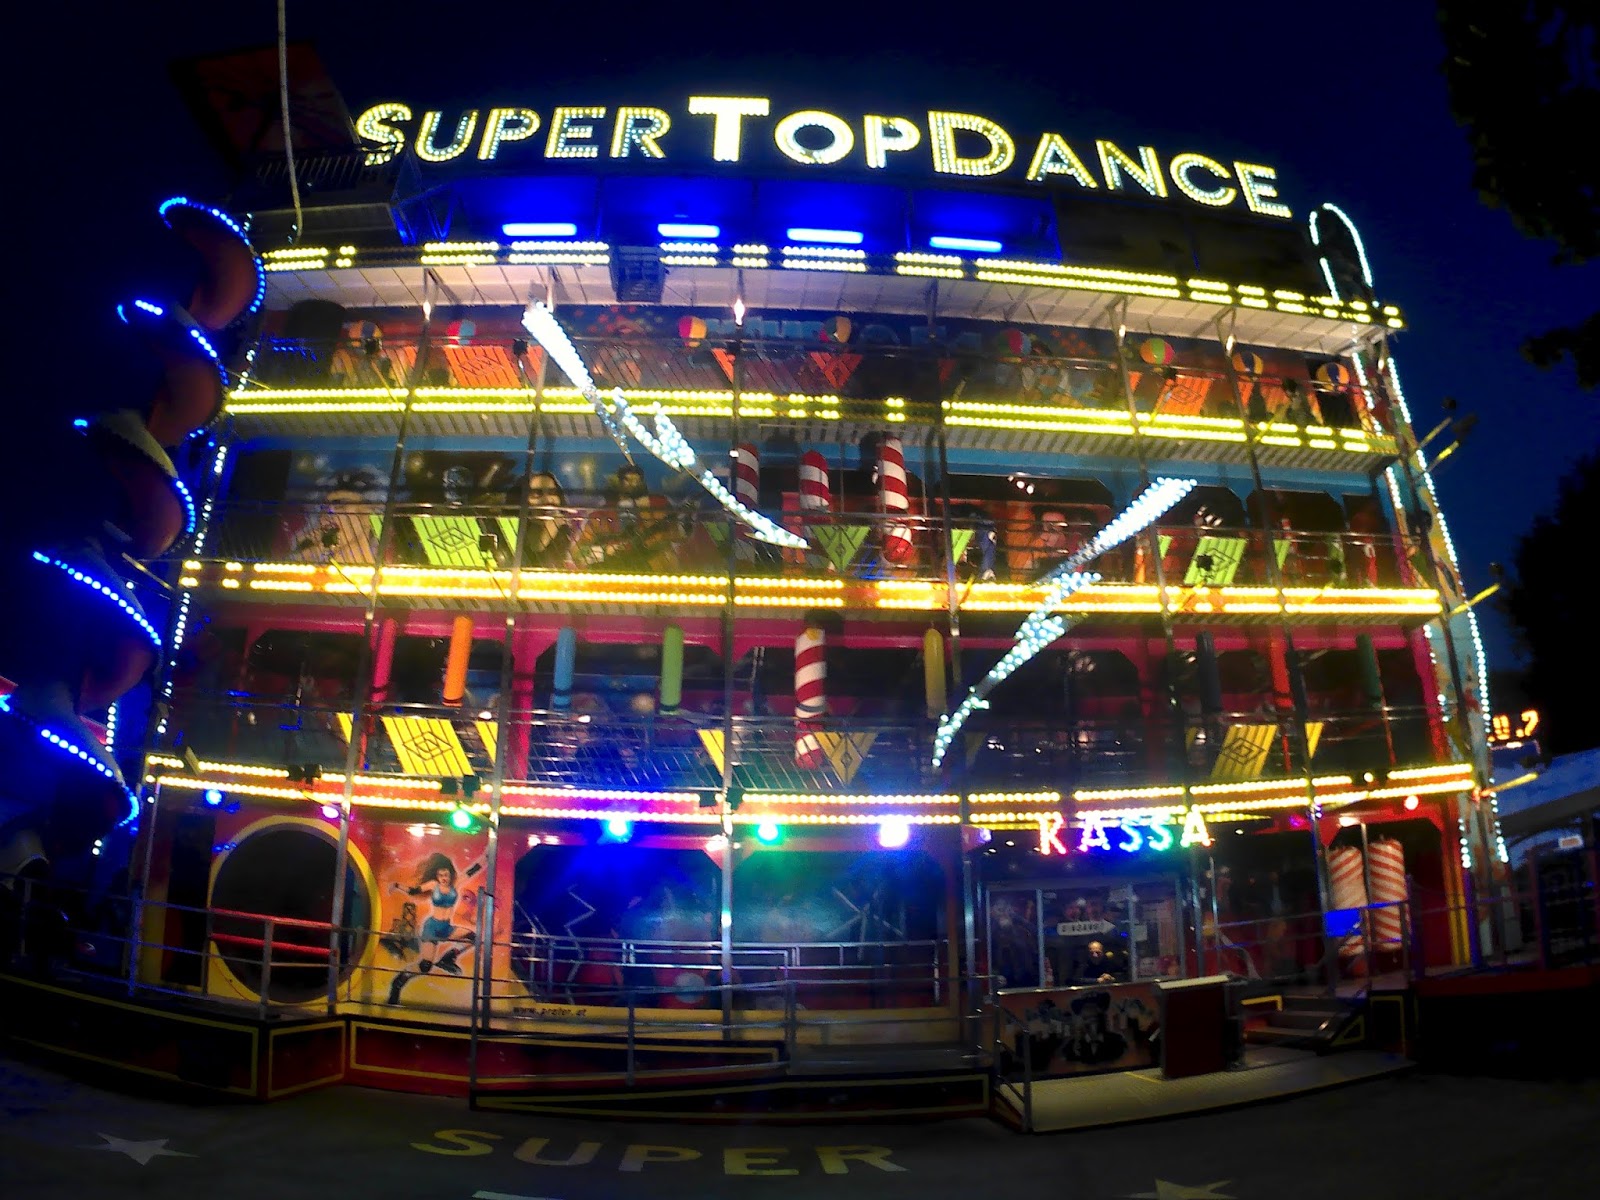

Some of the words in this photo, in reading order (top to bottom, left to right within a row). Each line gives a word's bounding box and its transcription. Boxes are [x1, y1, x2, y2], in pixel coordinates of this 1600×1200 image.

[355, 102, 672, 167] SUPER
[688, 96, 921, 169] TOP
[927, 110, 1293, 219] DANCE
[1036, 811, 1212, 856] KASSA
[410, 1128, 908, 1176] SUPER
